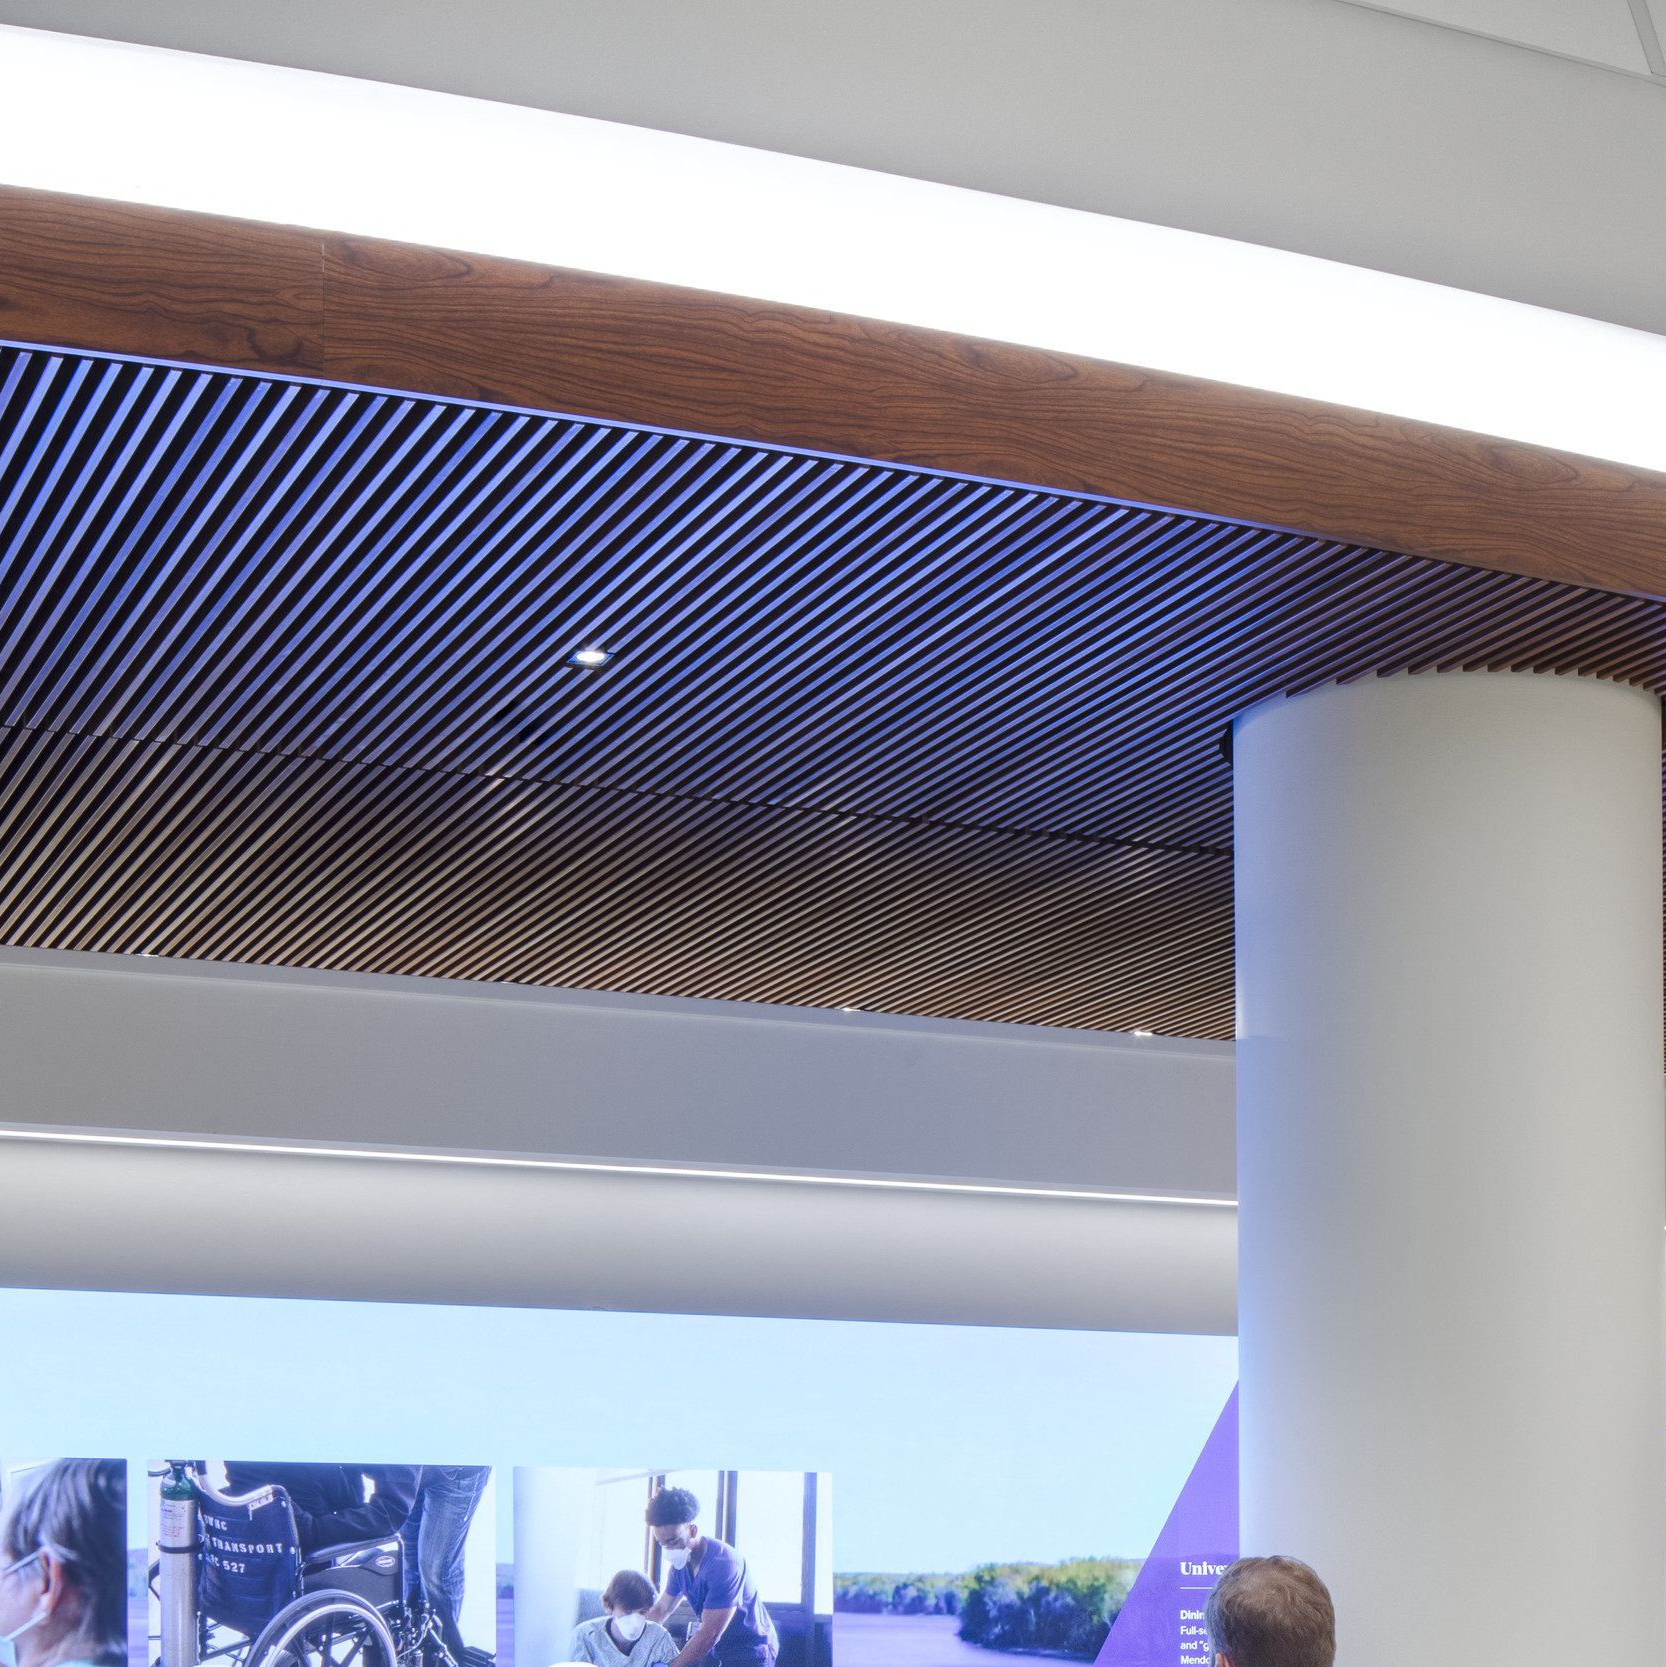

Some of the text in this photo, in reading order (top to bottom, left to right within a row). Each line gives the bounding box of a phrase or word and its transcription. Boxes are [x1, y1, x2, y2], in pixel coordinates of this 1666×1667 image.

[212, 1537, 283, 1554] TRANSPORT
[222, 1560, 246, 1574] 527
[1180, 1610, 1204, 1620] Dinin
[1180, 1641, 1198, 1650] and
[1180, 1655, 1210, 1664] Mendo
